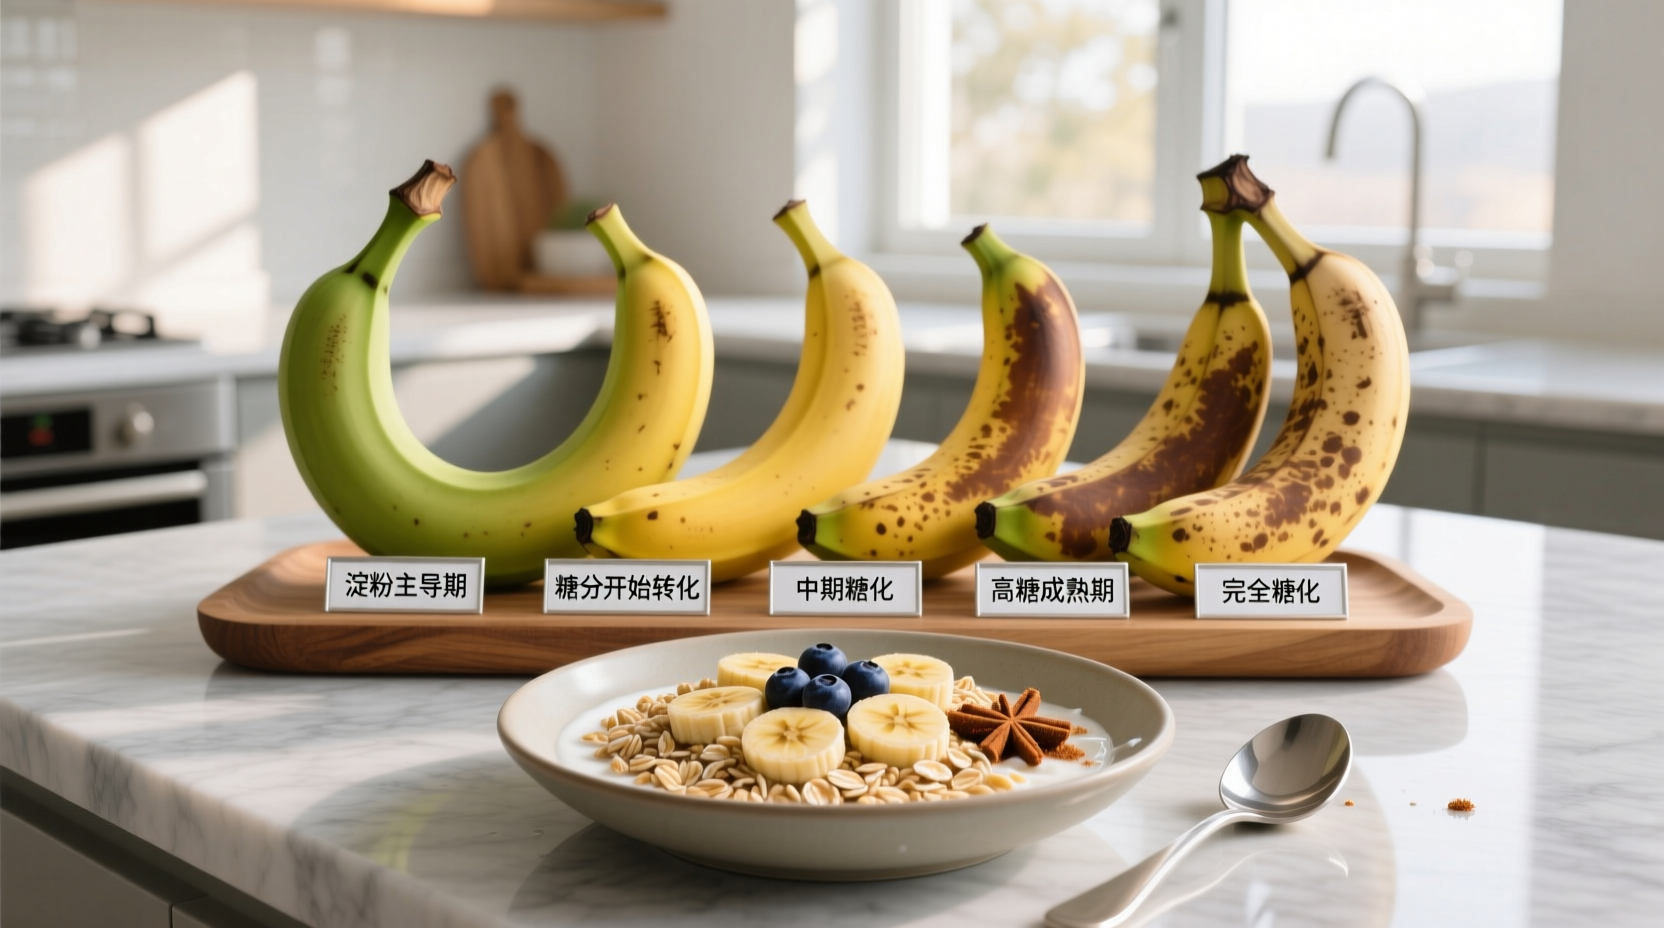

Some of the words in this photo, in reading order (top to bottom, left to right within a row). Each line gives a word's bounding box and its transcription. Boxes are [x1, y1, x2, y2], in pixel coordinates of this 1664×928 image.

[345, 571, 467, 599] 淀粉主导期
[554, 573, 700, 601] 糖分开始转化
[797, 575, 894, 602] 中期糖化
[991, 576, 1114, 604] 高糖成熟期
[1222, 577, 1320, 605] 完全糖化
